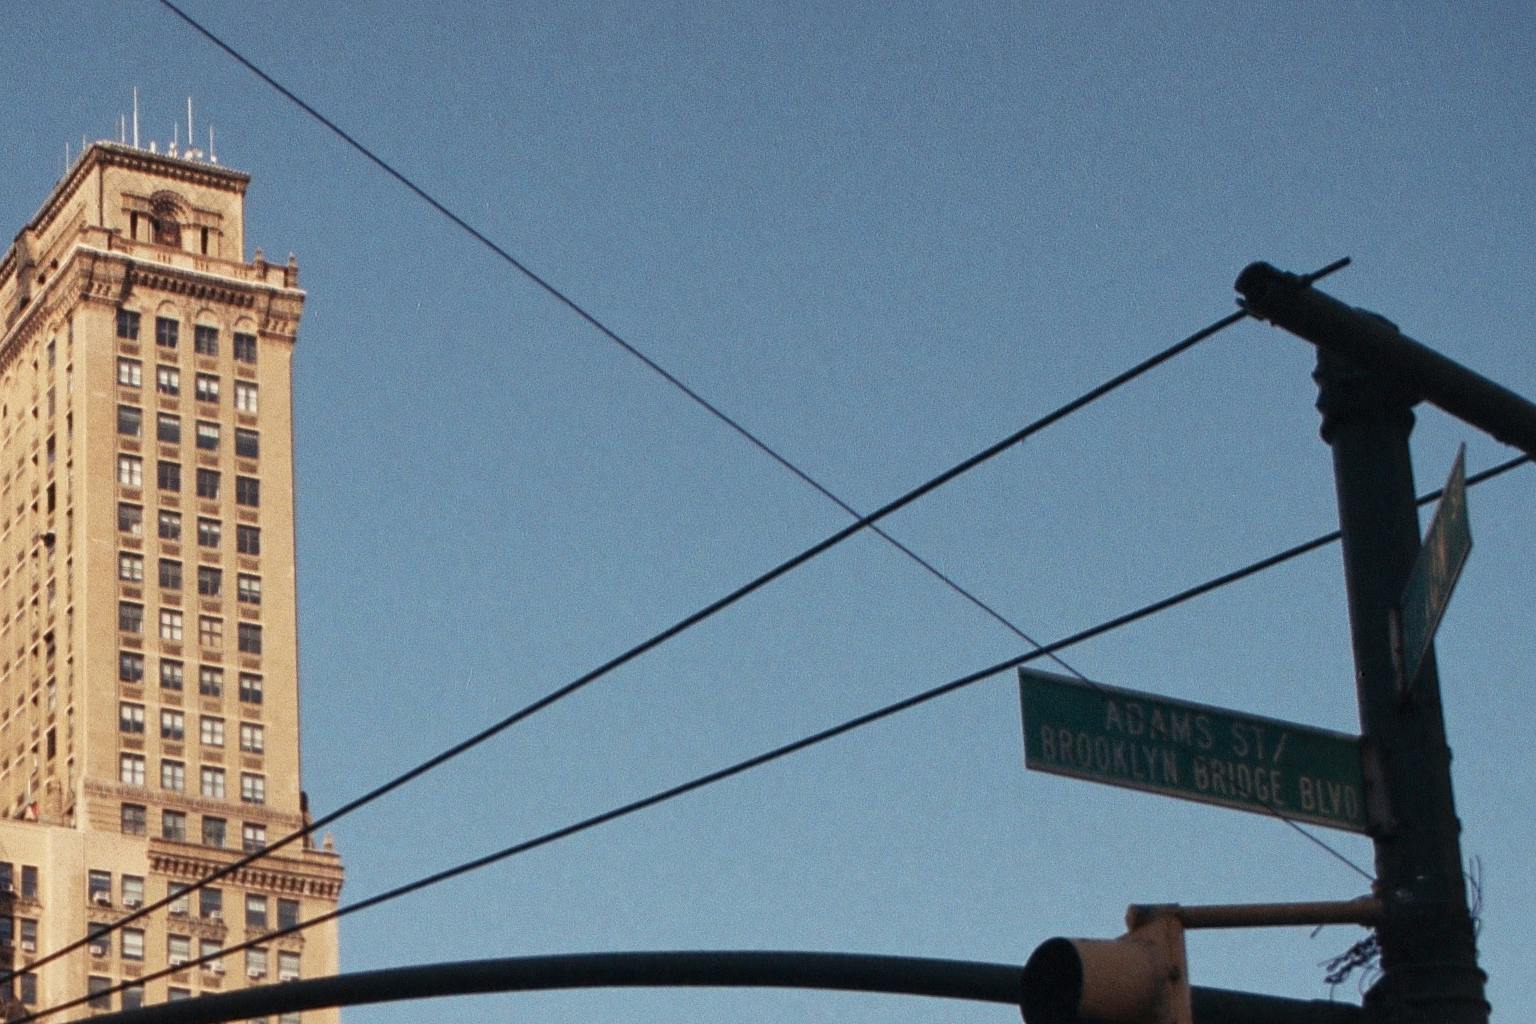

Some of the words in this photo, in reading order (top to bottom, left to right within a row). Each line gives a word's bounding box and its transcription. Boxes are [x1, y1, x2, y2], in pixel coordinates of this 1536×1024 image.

[1106, 700, 1213, 749] ADAMS
[1041, 725, 1178, 783] BROOKLYN
[1193, 756, 1284, 806] BRIDGE
[1298, 776, 1358, 820] BLVD
